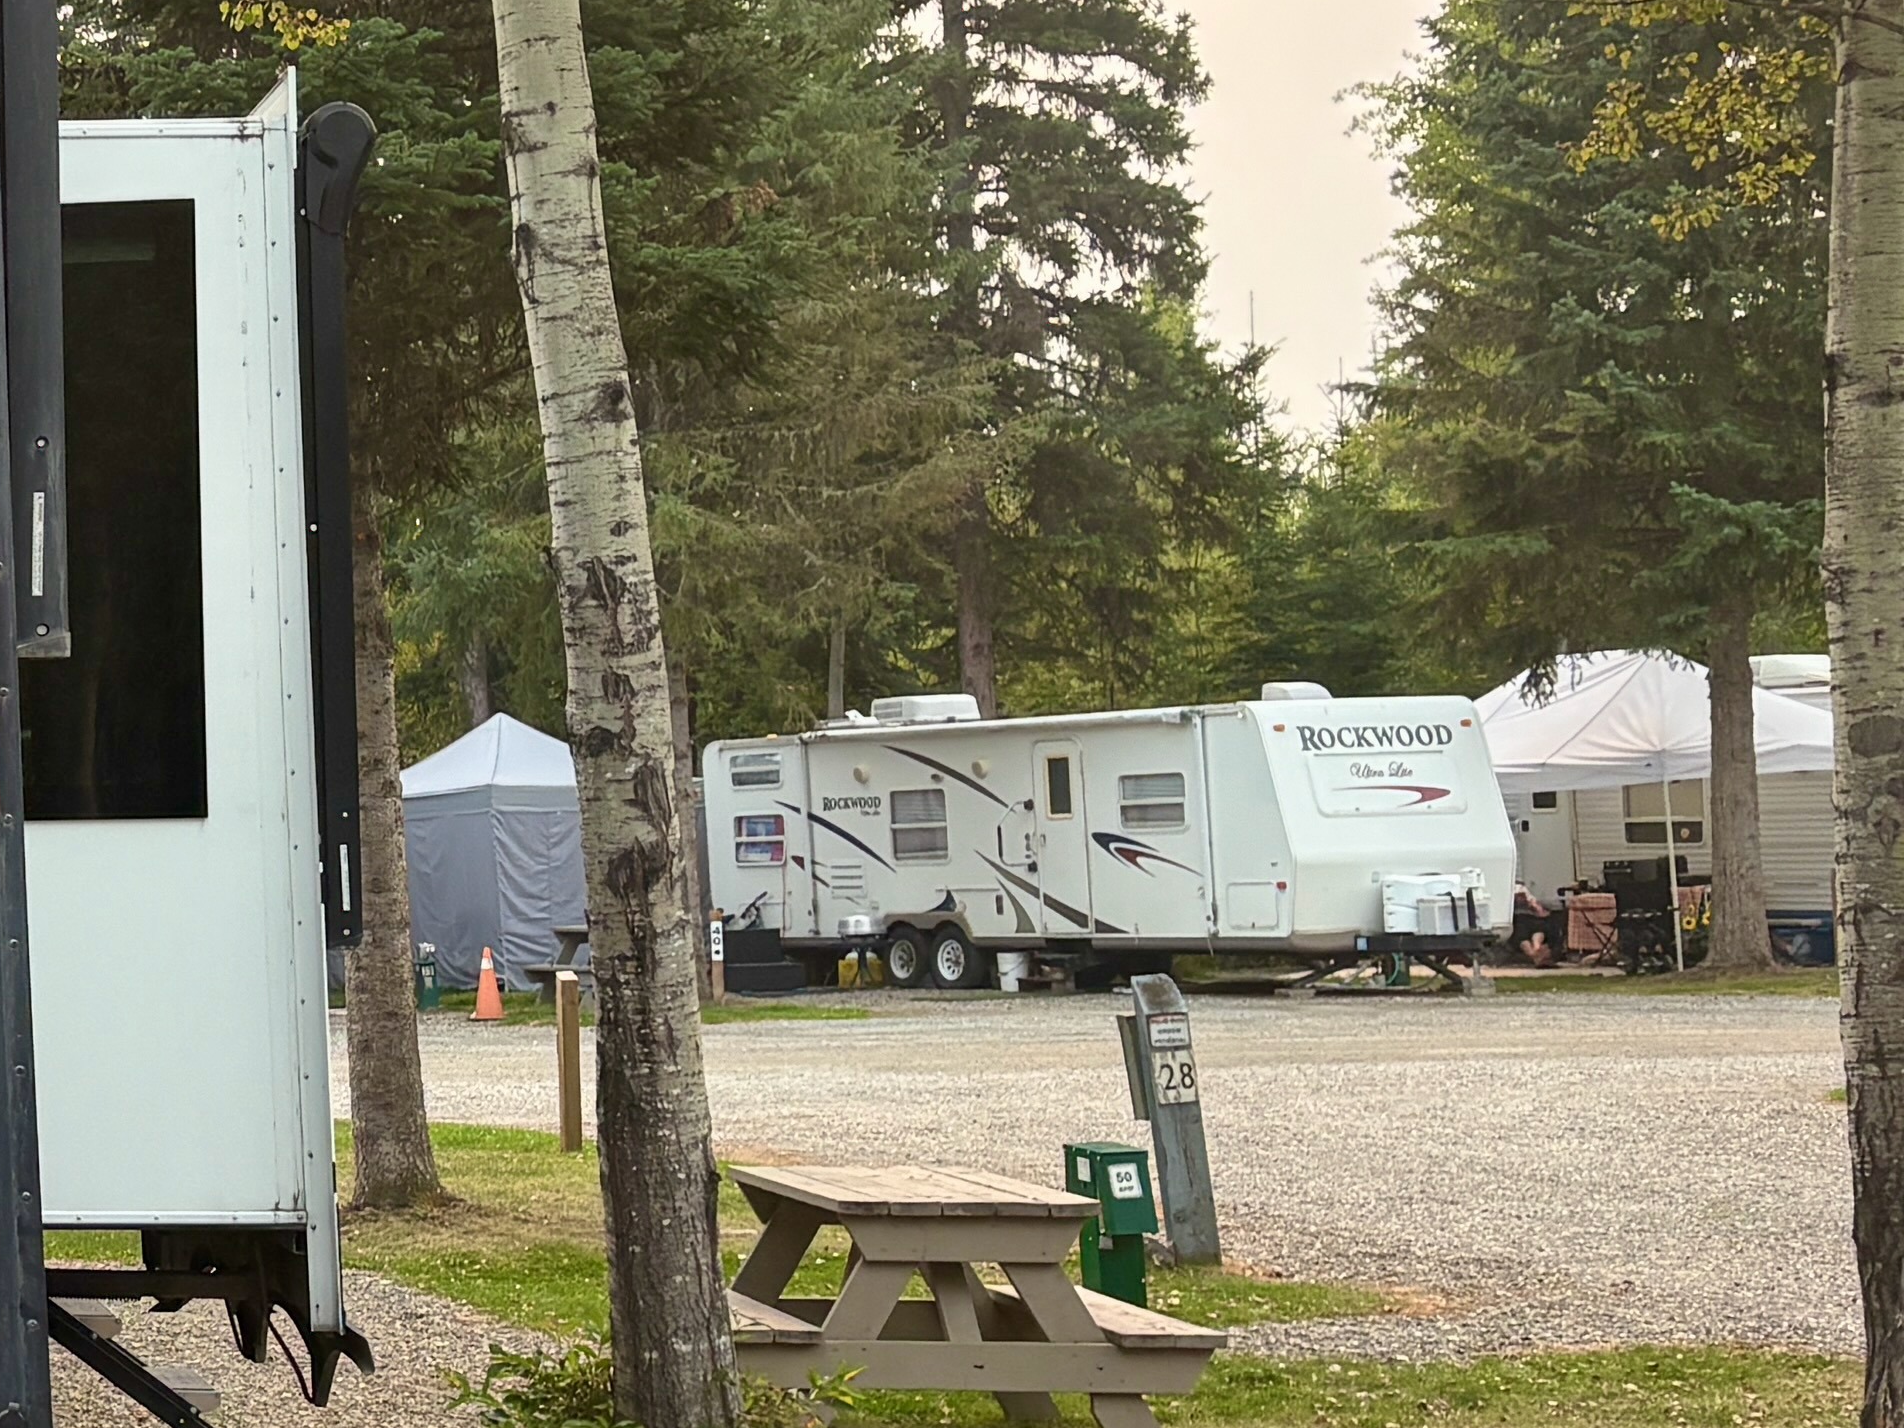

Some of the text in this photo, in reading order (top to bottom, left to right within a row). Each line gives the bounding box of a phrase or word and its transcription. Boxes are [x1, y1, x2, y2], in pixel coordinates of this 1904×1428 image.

[1296, 724, 1453, 751] ROCKWOOD
[823, 796, 881, 811] ROCKWOOD
[1158, 1062, 1195, 1090] 28
[1116, 1171, 1133, 1183] 50
